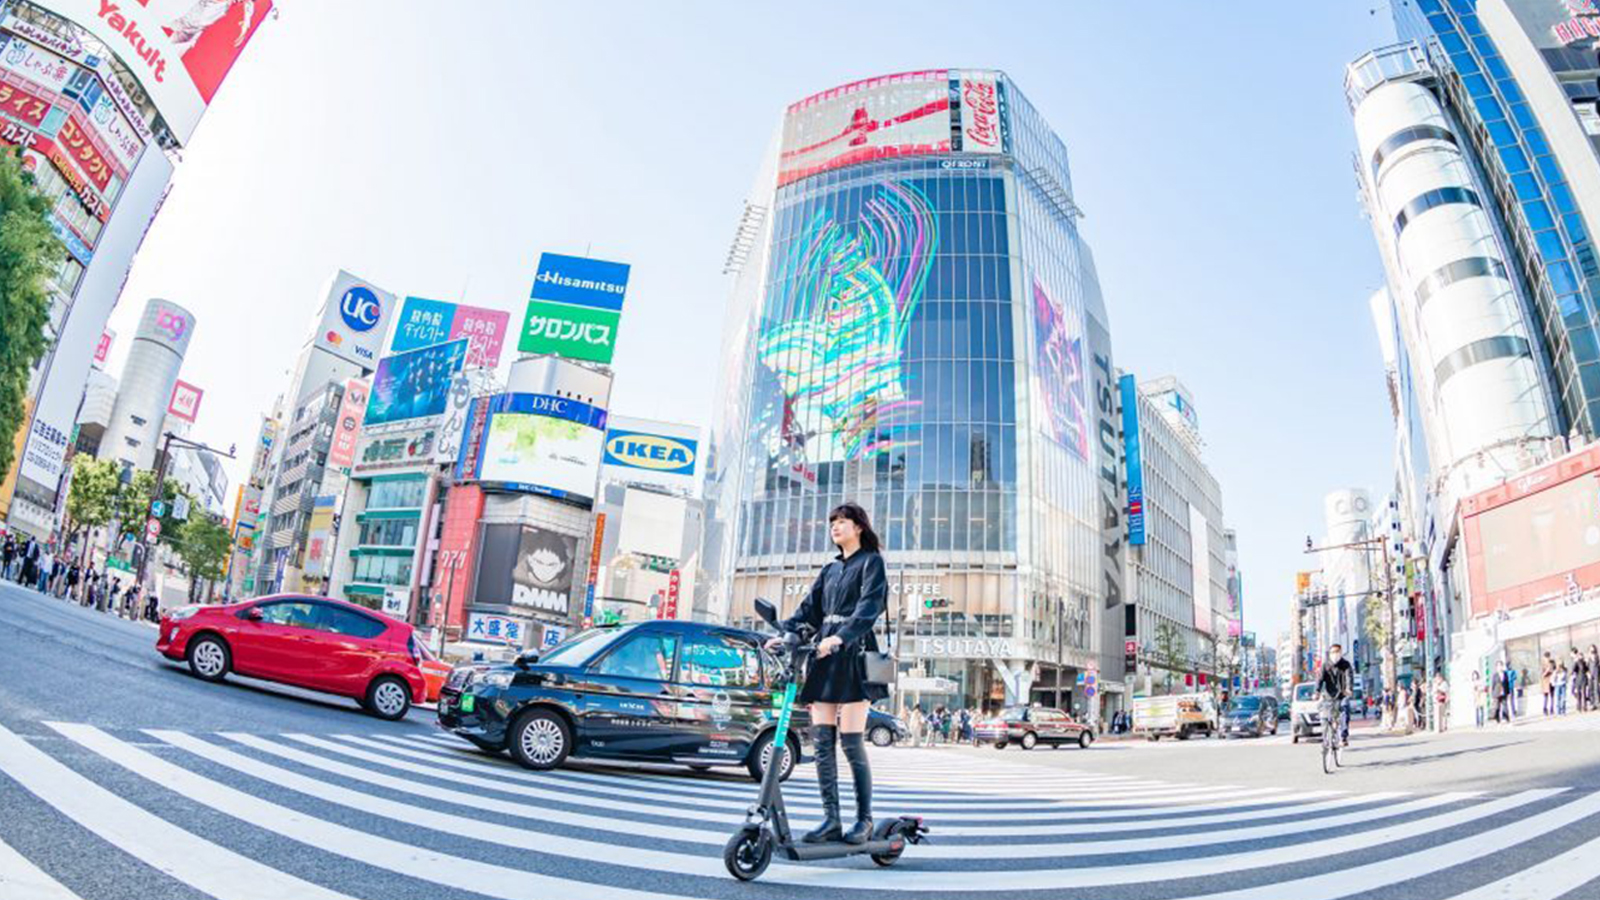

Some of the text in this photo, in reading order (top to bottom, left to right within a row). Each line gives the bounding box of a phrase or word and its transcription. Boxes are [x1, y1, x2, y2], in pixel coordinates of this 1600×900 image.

[98, 0, 165, 82] Yakult
[1552, 16, 1600, 44] MAG
[61, 118, 110, 182] コンタクト
[536, 270, 625, 295] Hisamitsu
[344, 292, 379, 325] UC
[529, 315, 610, 346] サロンパス
[354, 345, 374, 361] VISA
[532, 396, 568, 413] DHC
[613, 439, 690, 464] IKEA
[1093, 352, 1122, 609] TSUTAYA
[512, 582, 568, 613] DMM
[887, 583, 941, 595] OFFEE
[472, 618, 520, 640] 大盛堂
[543, 628, 560, 646] 店
[919, 639, 1013, 656] TSUTAYA
